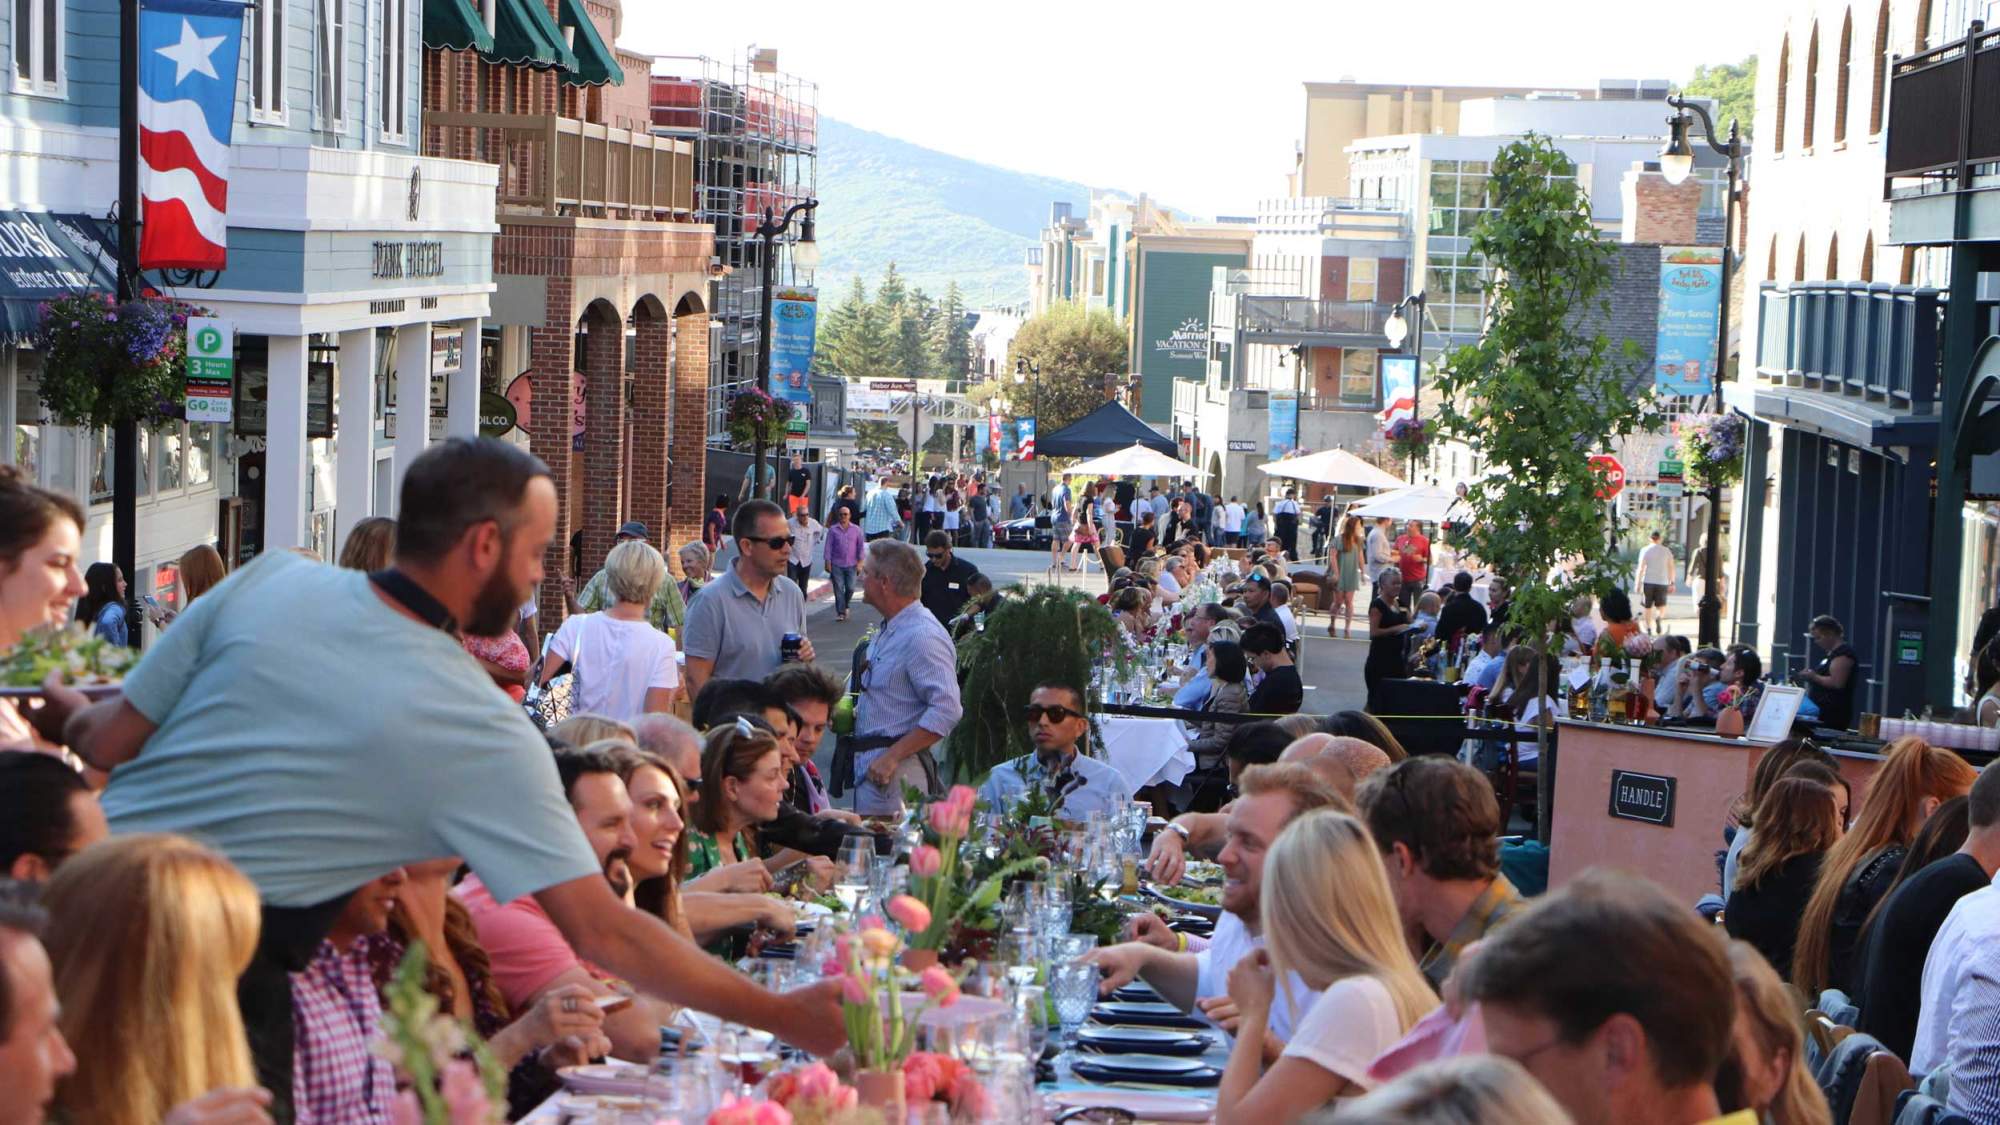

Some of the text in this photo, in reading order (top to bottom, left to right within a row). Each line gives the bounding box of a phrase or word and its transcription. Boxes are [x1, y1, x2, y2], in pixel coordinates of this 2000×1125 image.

[203, 332, 216, 350] P
[1156, 339, 1200, 349] VACATION
[191, 359, 202, 374] 3
[1621, 785, 1664, 808] HANDLE
